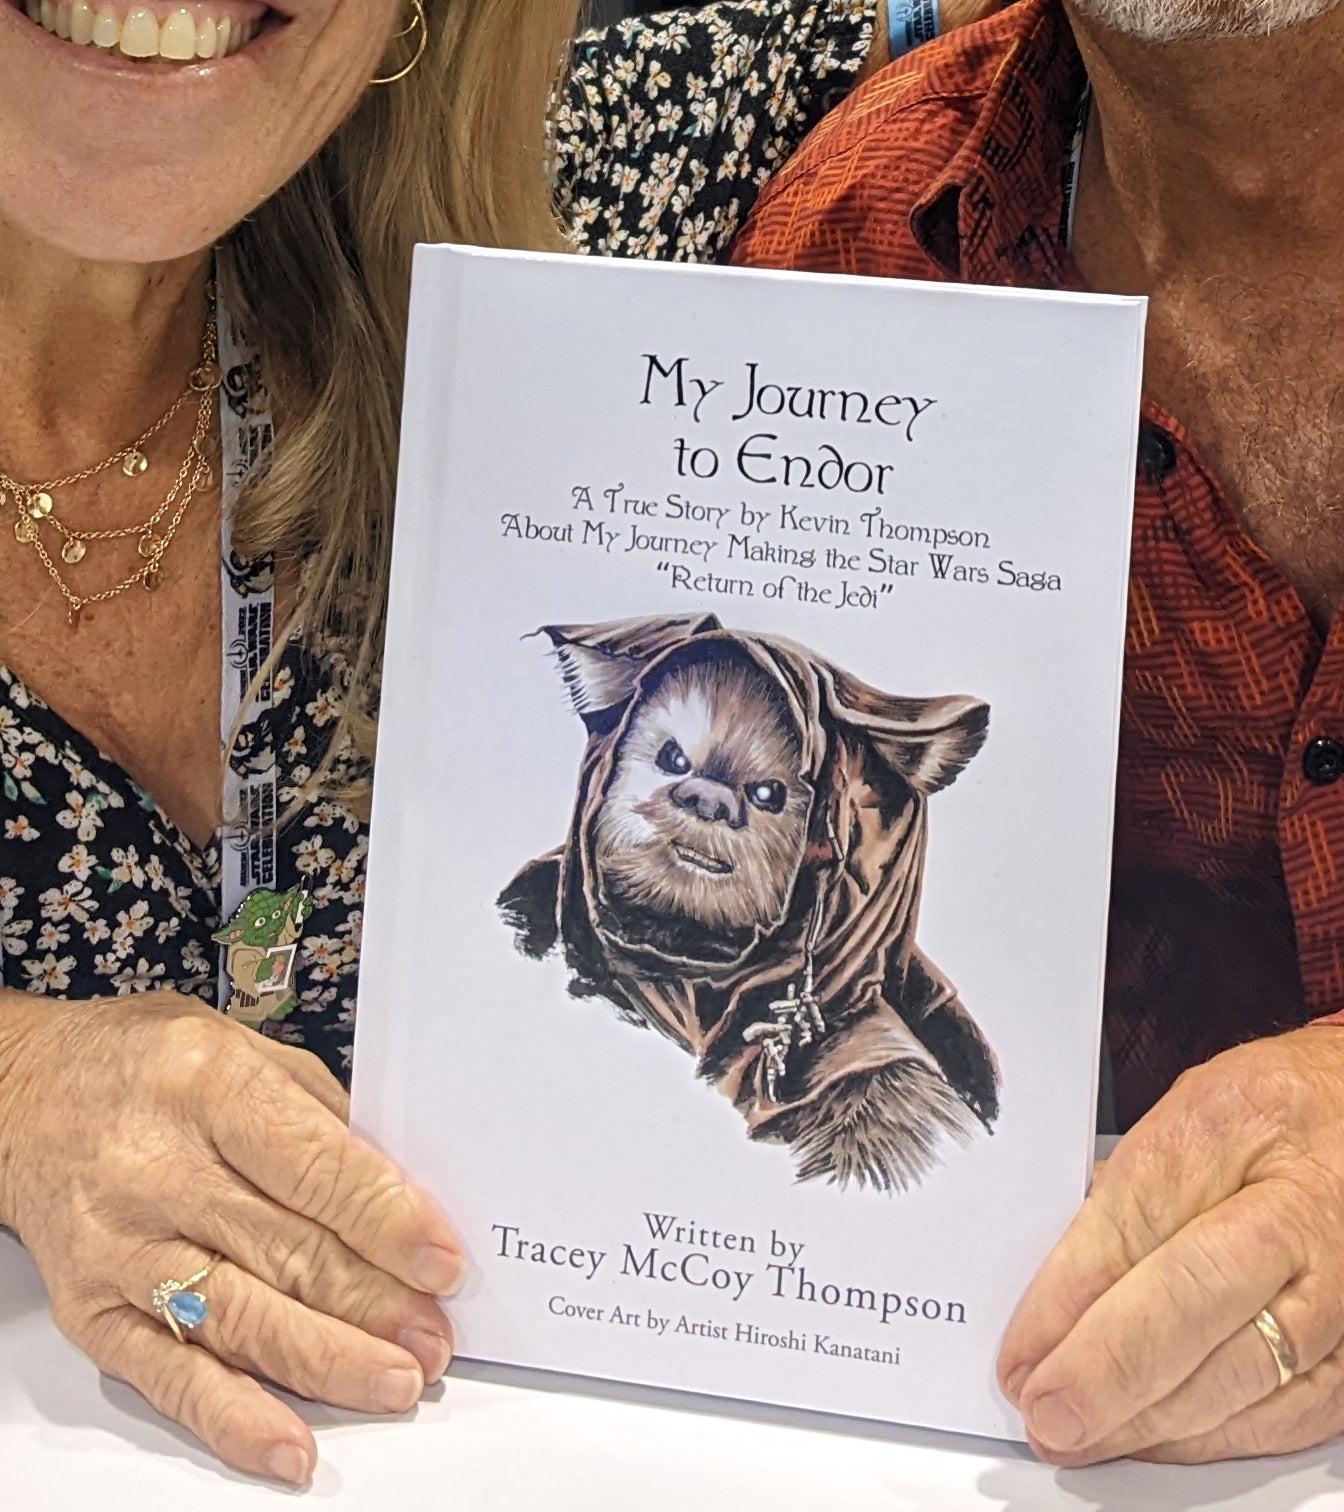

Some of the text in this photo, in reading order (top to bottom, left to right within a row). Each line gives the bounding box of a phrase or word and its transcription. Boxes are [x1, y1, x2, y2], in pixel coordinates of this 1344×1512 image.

[640, 354, 937, 442] My Journey
[674, 434, 894, 495] to Endor
[572, 483, 990, 549] A True Story by Kevin Thompson
[501, 514, 1061, 591] About My Journey Making the Star Wars Saga
[763, 576, 796, 599] of
[798, 581, 832, 604] the
[643, 1213, 806, 1267] Written by
[492, 1224, 967, 1325] Tracey McCoy Thompson
[549, 1296, 900, 1365] Cover Art by Artist Hiroshi Kanatani
